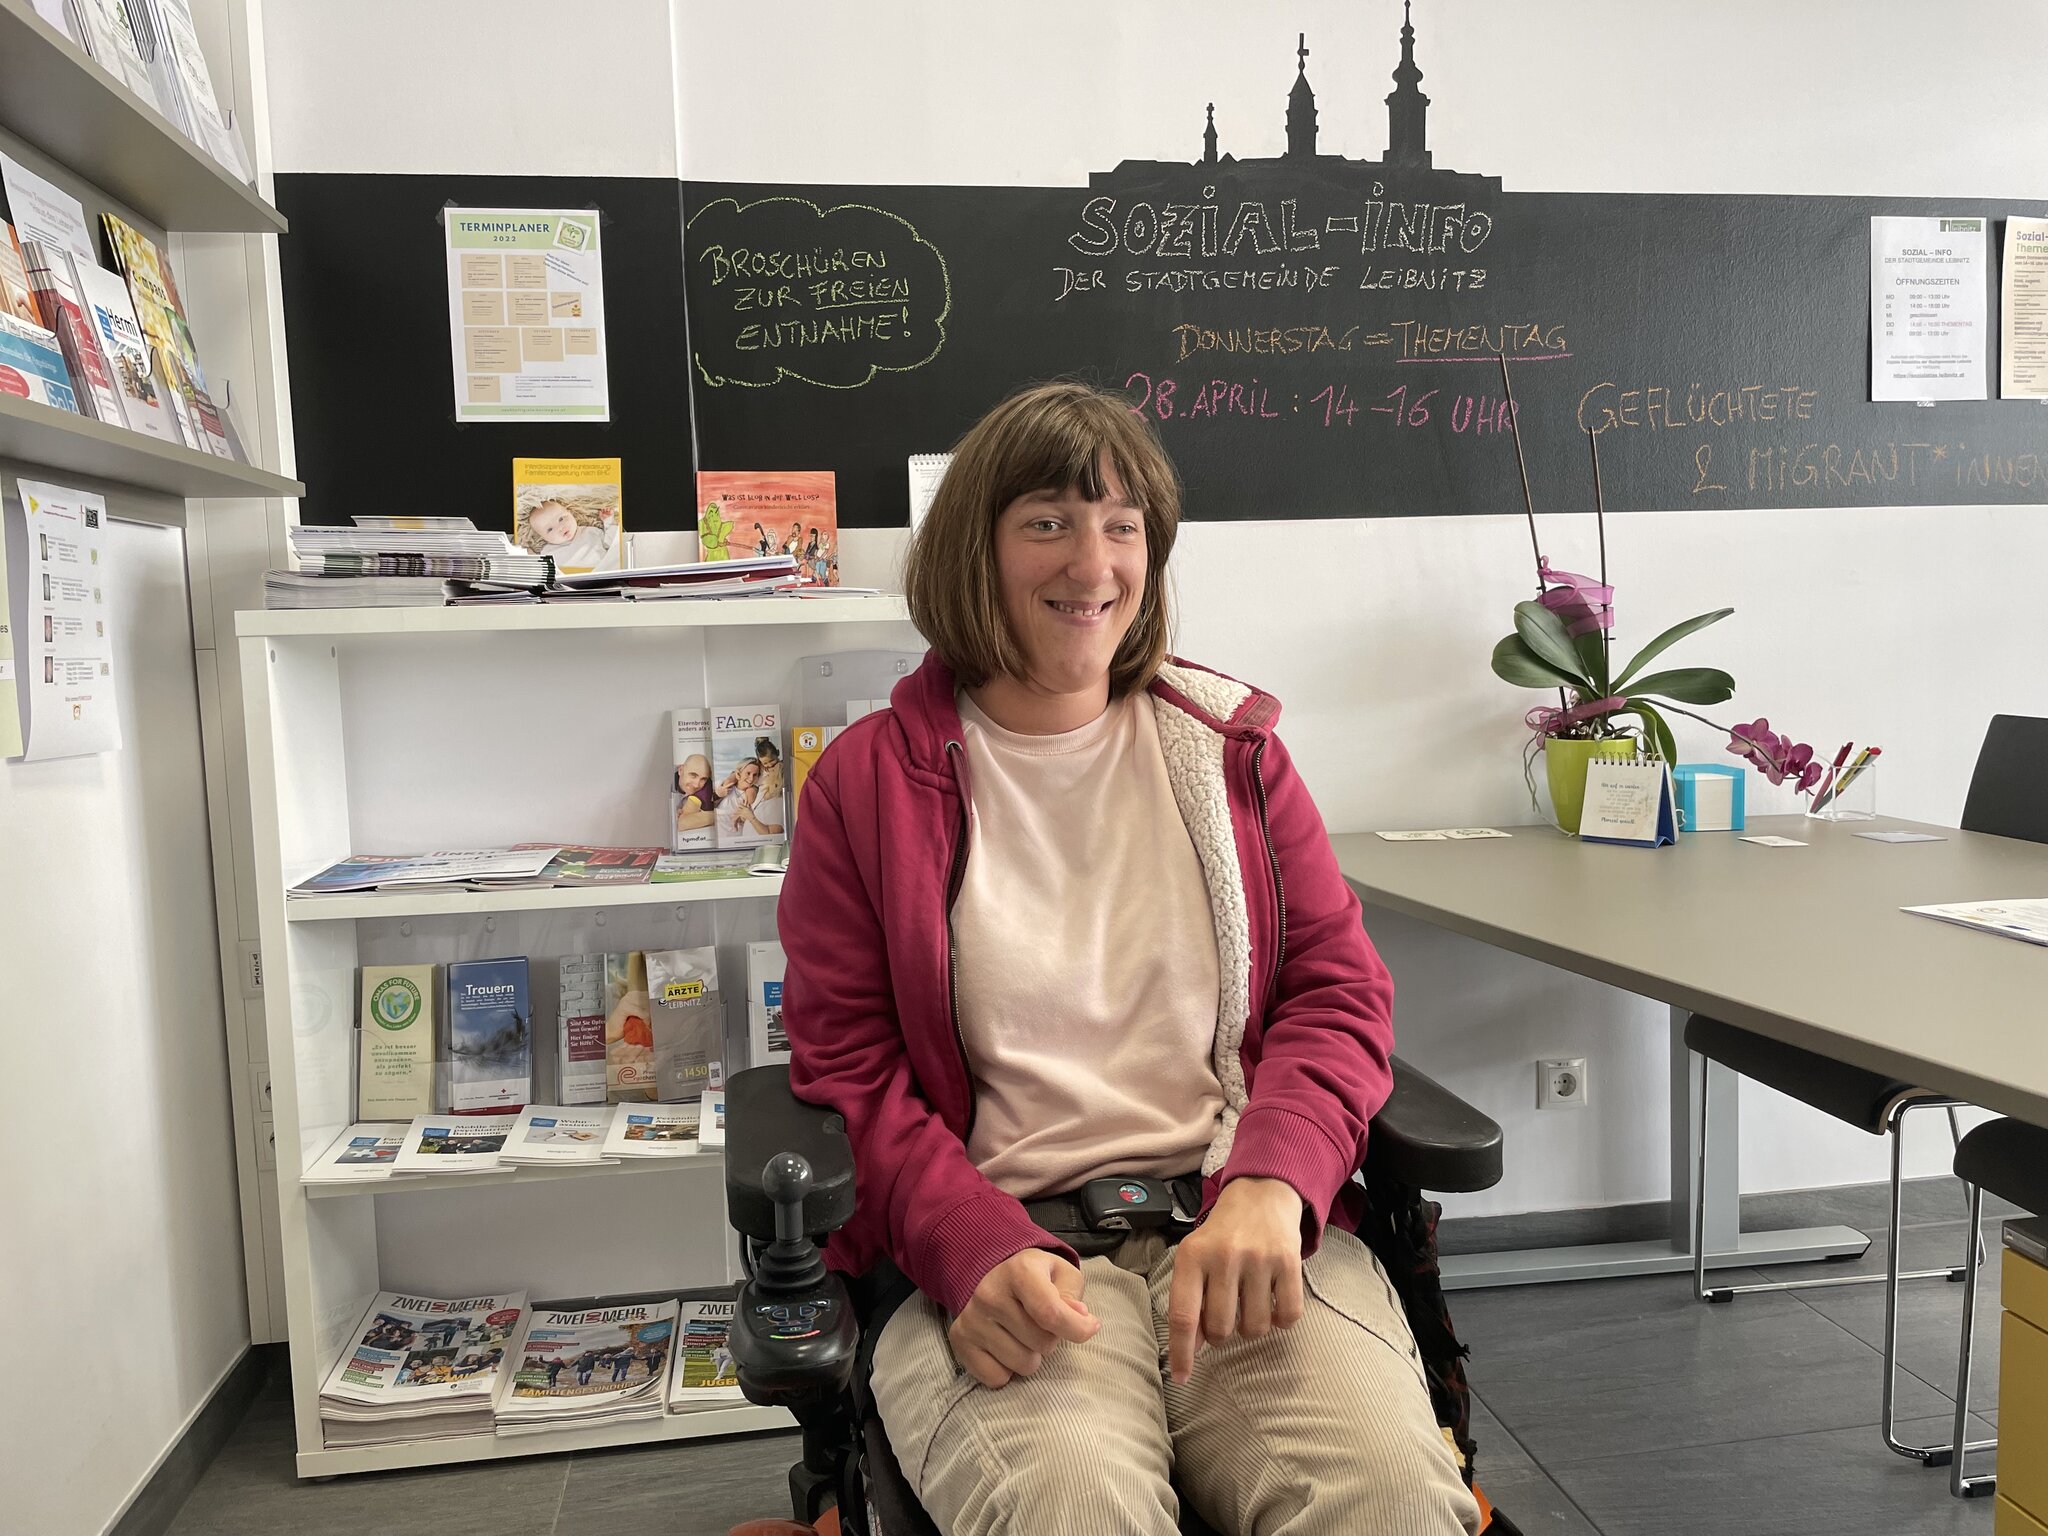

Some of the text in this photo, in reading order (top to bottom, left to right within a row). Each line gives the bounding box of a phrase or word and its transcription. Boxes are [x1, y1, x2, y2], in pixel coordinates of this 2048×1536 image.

[460, 222, 550, 233] TERMINPLANER
[700, 245, 886, 285] BROSCHÜREN
[1053, 263, 1487, 301] DER STADTGEMEINDE LEIBNITZ
[1895, 277, 1960, 286] ÖFFNUNGSZEITEN
[735, 285, 801, 310] ZUR
[735, 308, 912, 351] ENTNAHME!
[1173, 323, 1359, 363] DONNERSTAG
[1391, 320, 1568, 353] THEMENTAG
[1452, 395, 1519, 435] UHR
[1576, 382, 1818, 435] GEFLÜCHTETE
[373, 978, 421, 1001] OMAS FOR FUTURE
[465, 984, 514, 995] Trauern
[668, 998, 702, 1009] LEIBNITZ
[684, 1065, 707, 1079] 1450
[391, 1296, 431, 1312] ZWEI
[447, 1298, 494, 1313] MEHR
[698, 1303, 734, 1315] ZWEI
[546, 1314, 585, 1325] ZWEI
[599, 1307, 646, 1322] MEHR
